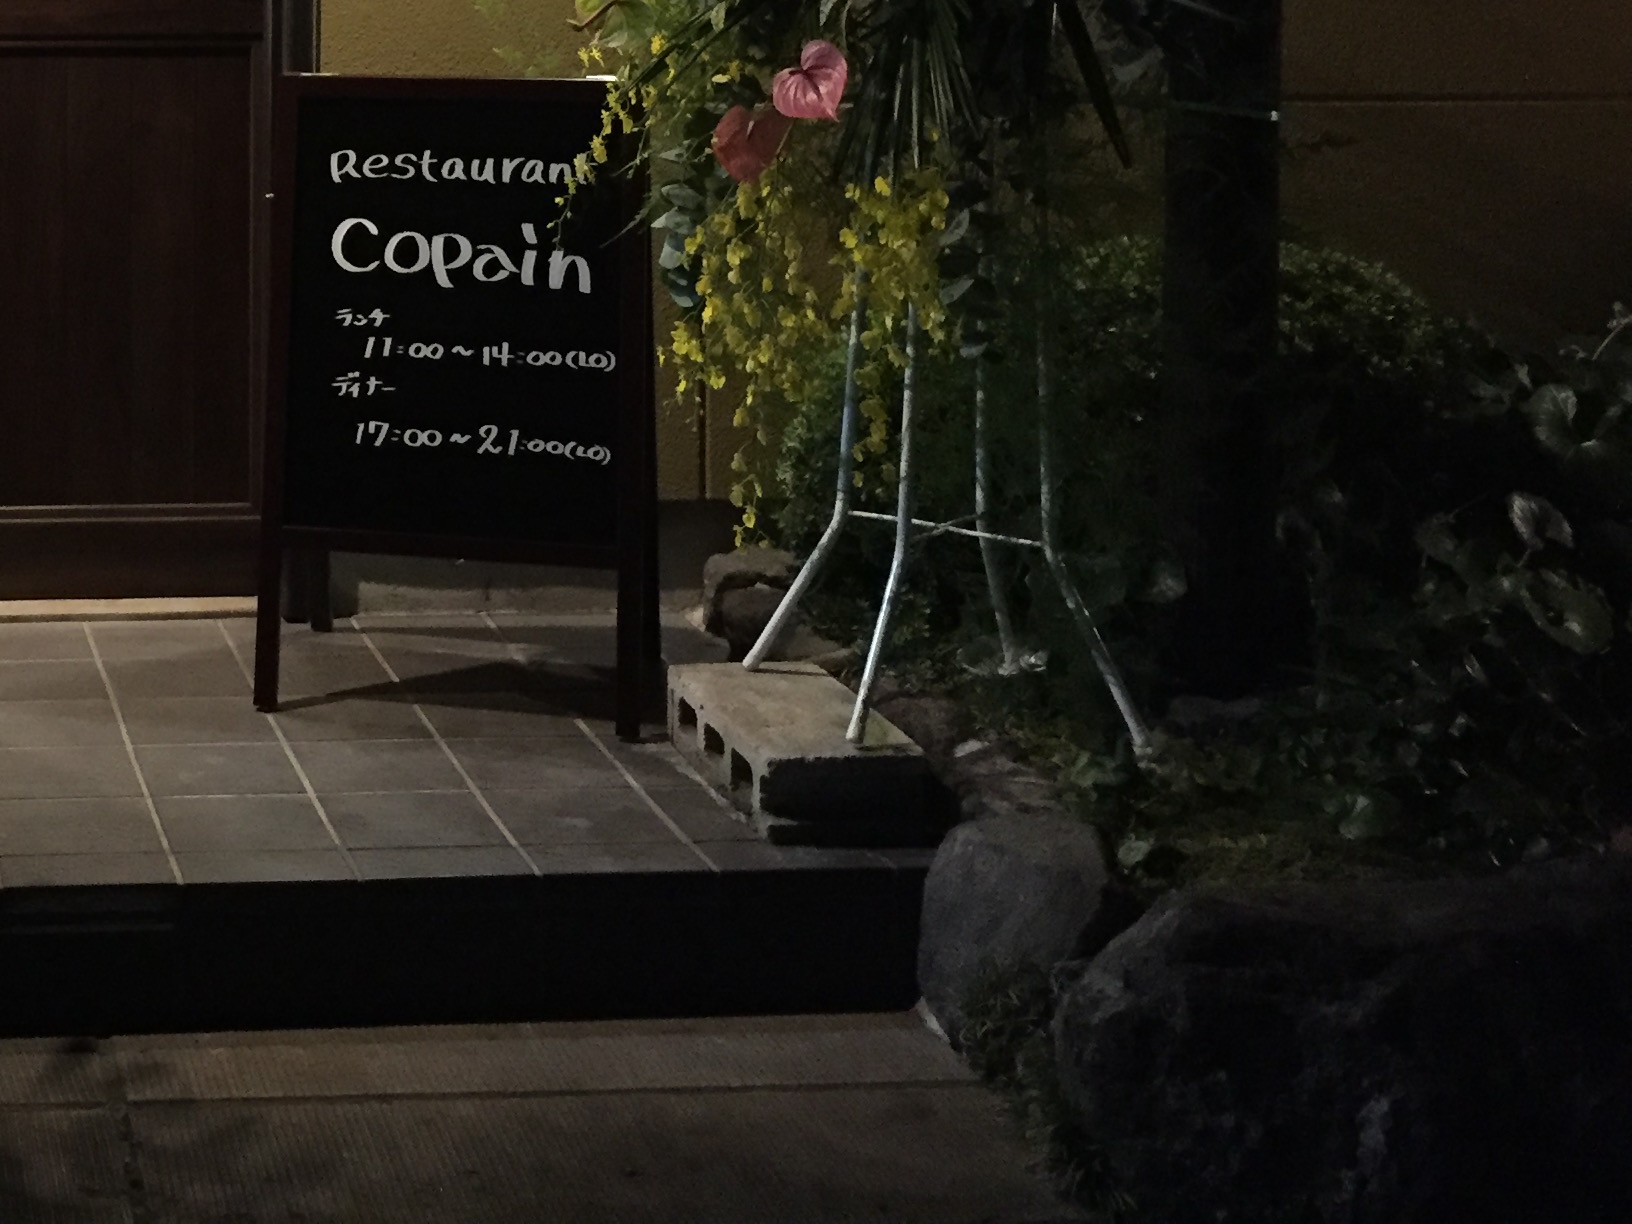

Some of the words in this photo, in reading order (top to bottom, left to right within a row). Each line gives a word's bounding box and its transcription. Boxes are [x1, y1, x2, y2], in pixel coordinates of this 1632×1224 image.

[331, 218, 591, 293] Copain
[335, 308, 390, 327] ランチ
[331, 371, 396, 398] ディナー
